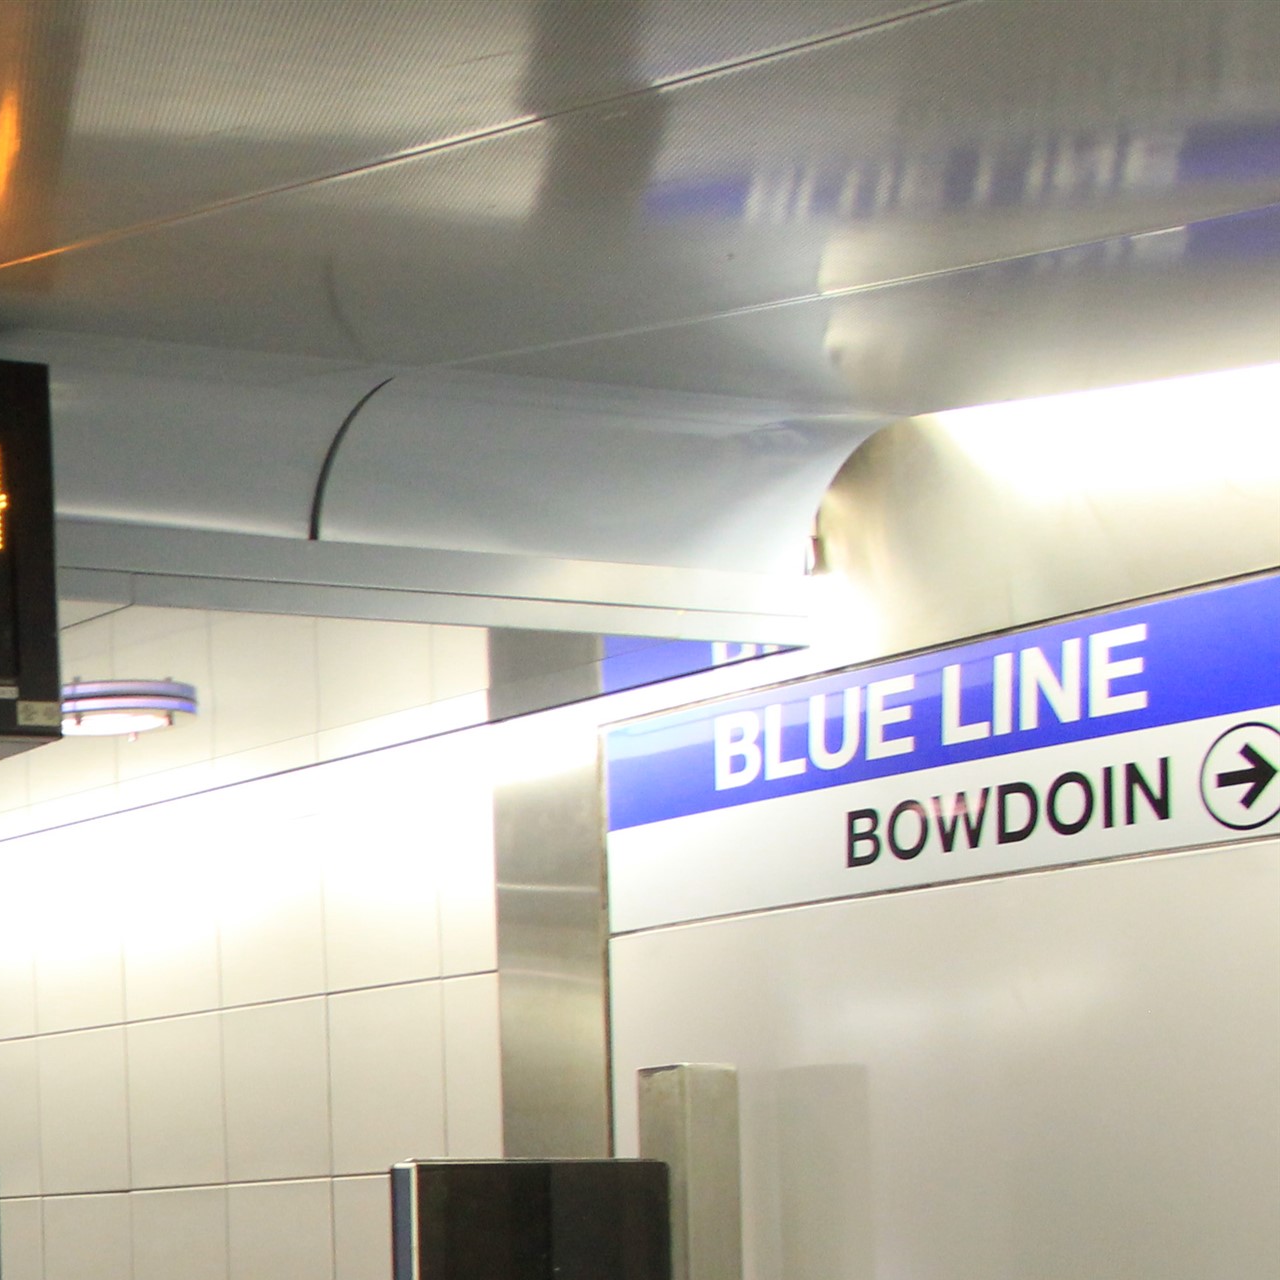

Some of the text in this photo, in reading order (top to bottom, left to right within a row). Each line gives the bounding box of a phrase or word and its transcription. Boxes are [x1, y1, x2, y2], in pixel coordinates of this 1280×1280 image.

[713, 623, 1149, 791] BLUE LINE
[845, 756, 1172, 868] BOWDOIN
